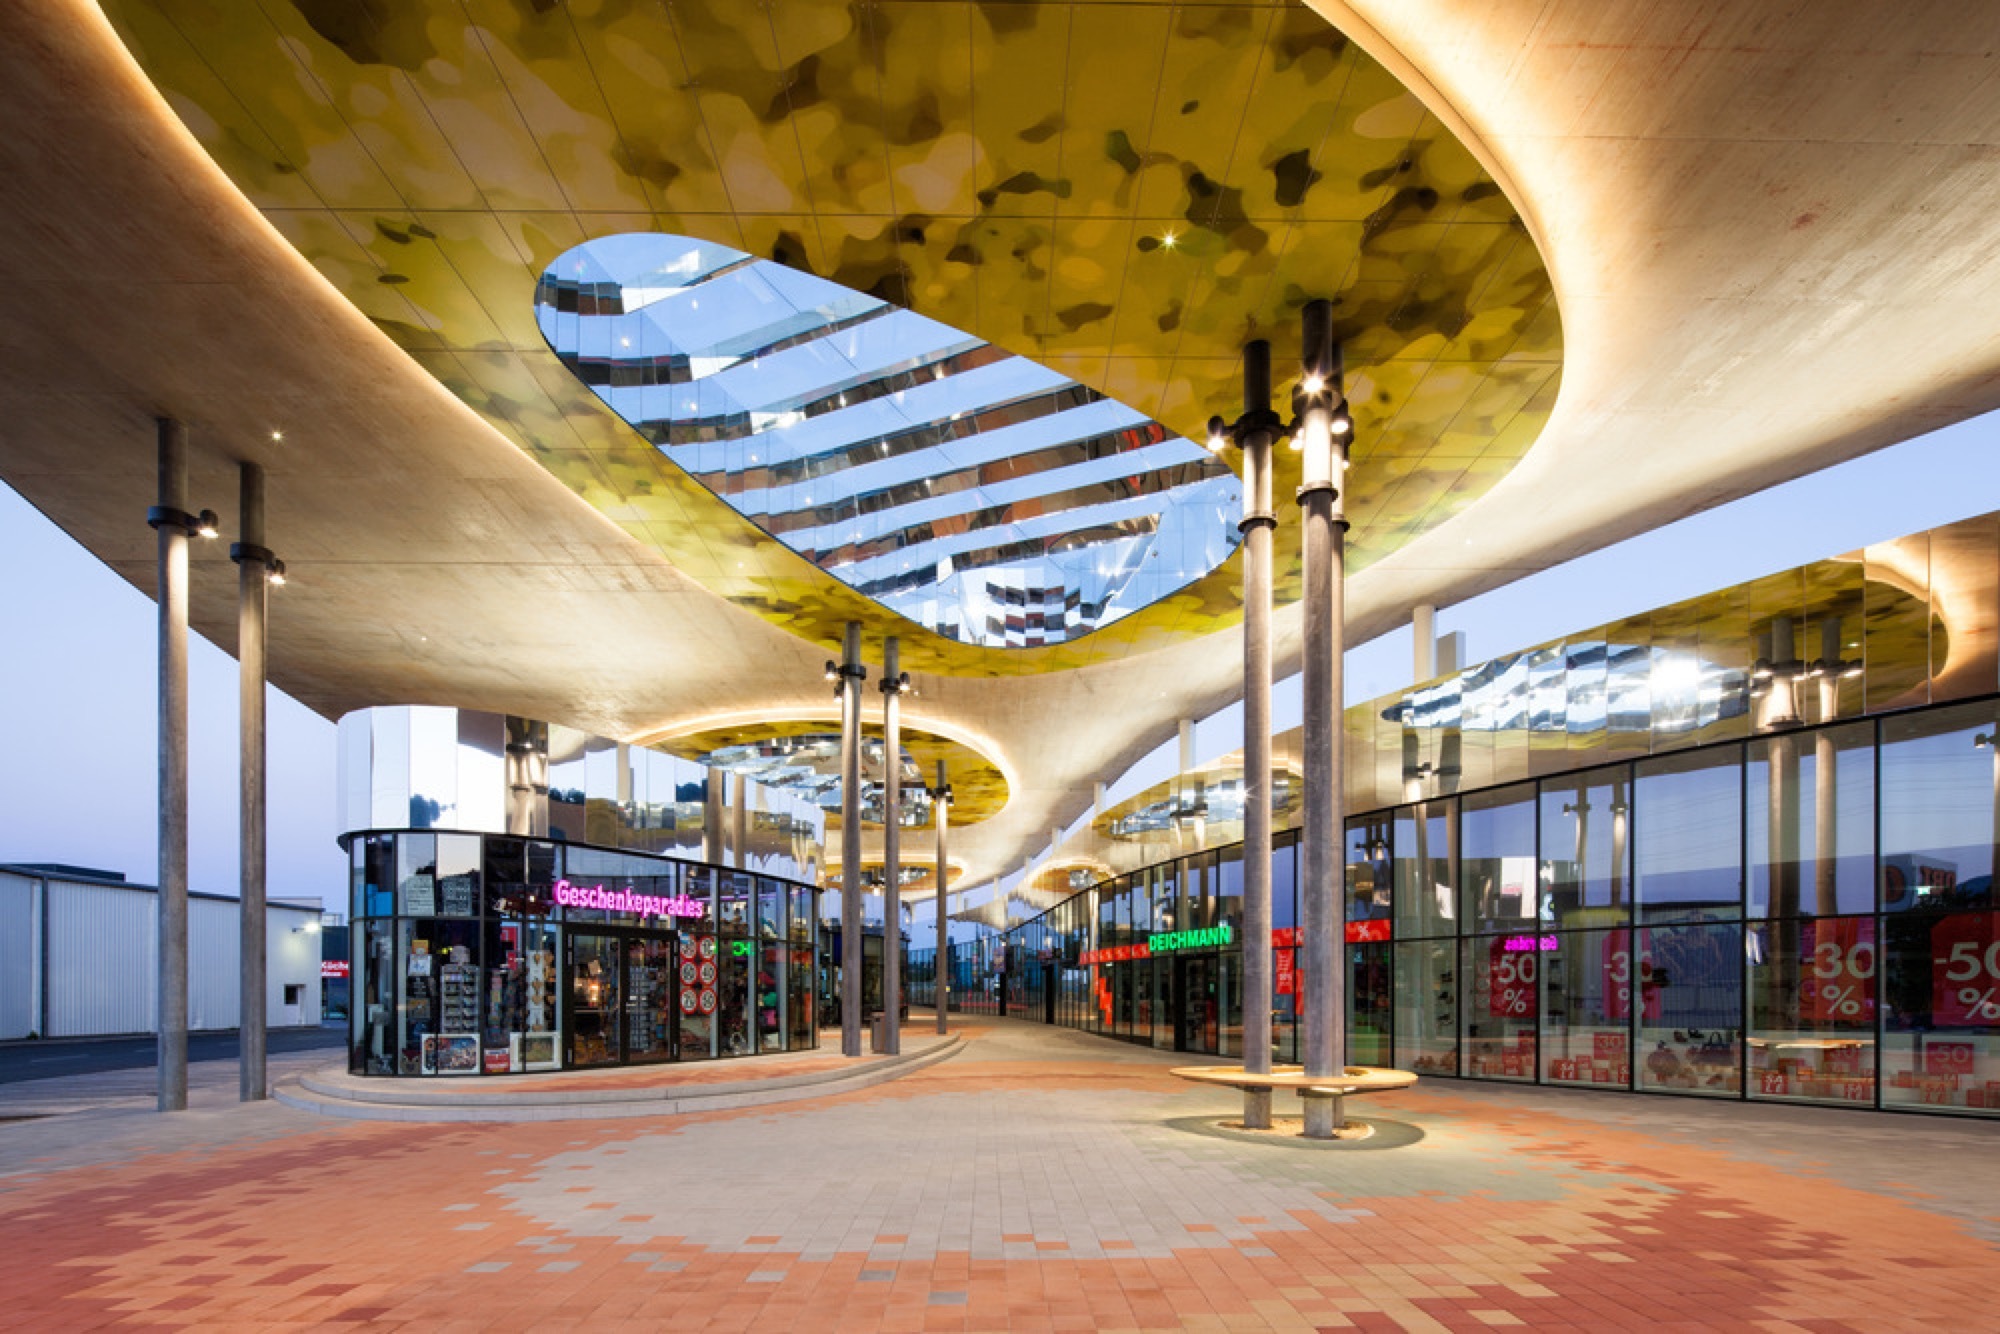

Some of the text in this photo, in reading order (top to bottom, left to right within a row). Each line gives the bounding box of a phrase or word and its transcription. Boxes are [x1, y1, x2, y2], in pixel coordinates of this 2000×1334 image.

[554, 880, 705, 918] Geschenkeparadies
[1149, 925, 1231, 951] DEICHMANN
[1804, 942, 1875, 978] -30
[1503, 988, 1528, 1013] %
[1822, 985, 1860, 1014] %
[1958, 988, 2000, 1018] %
